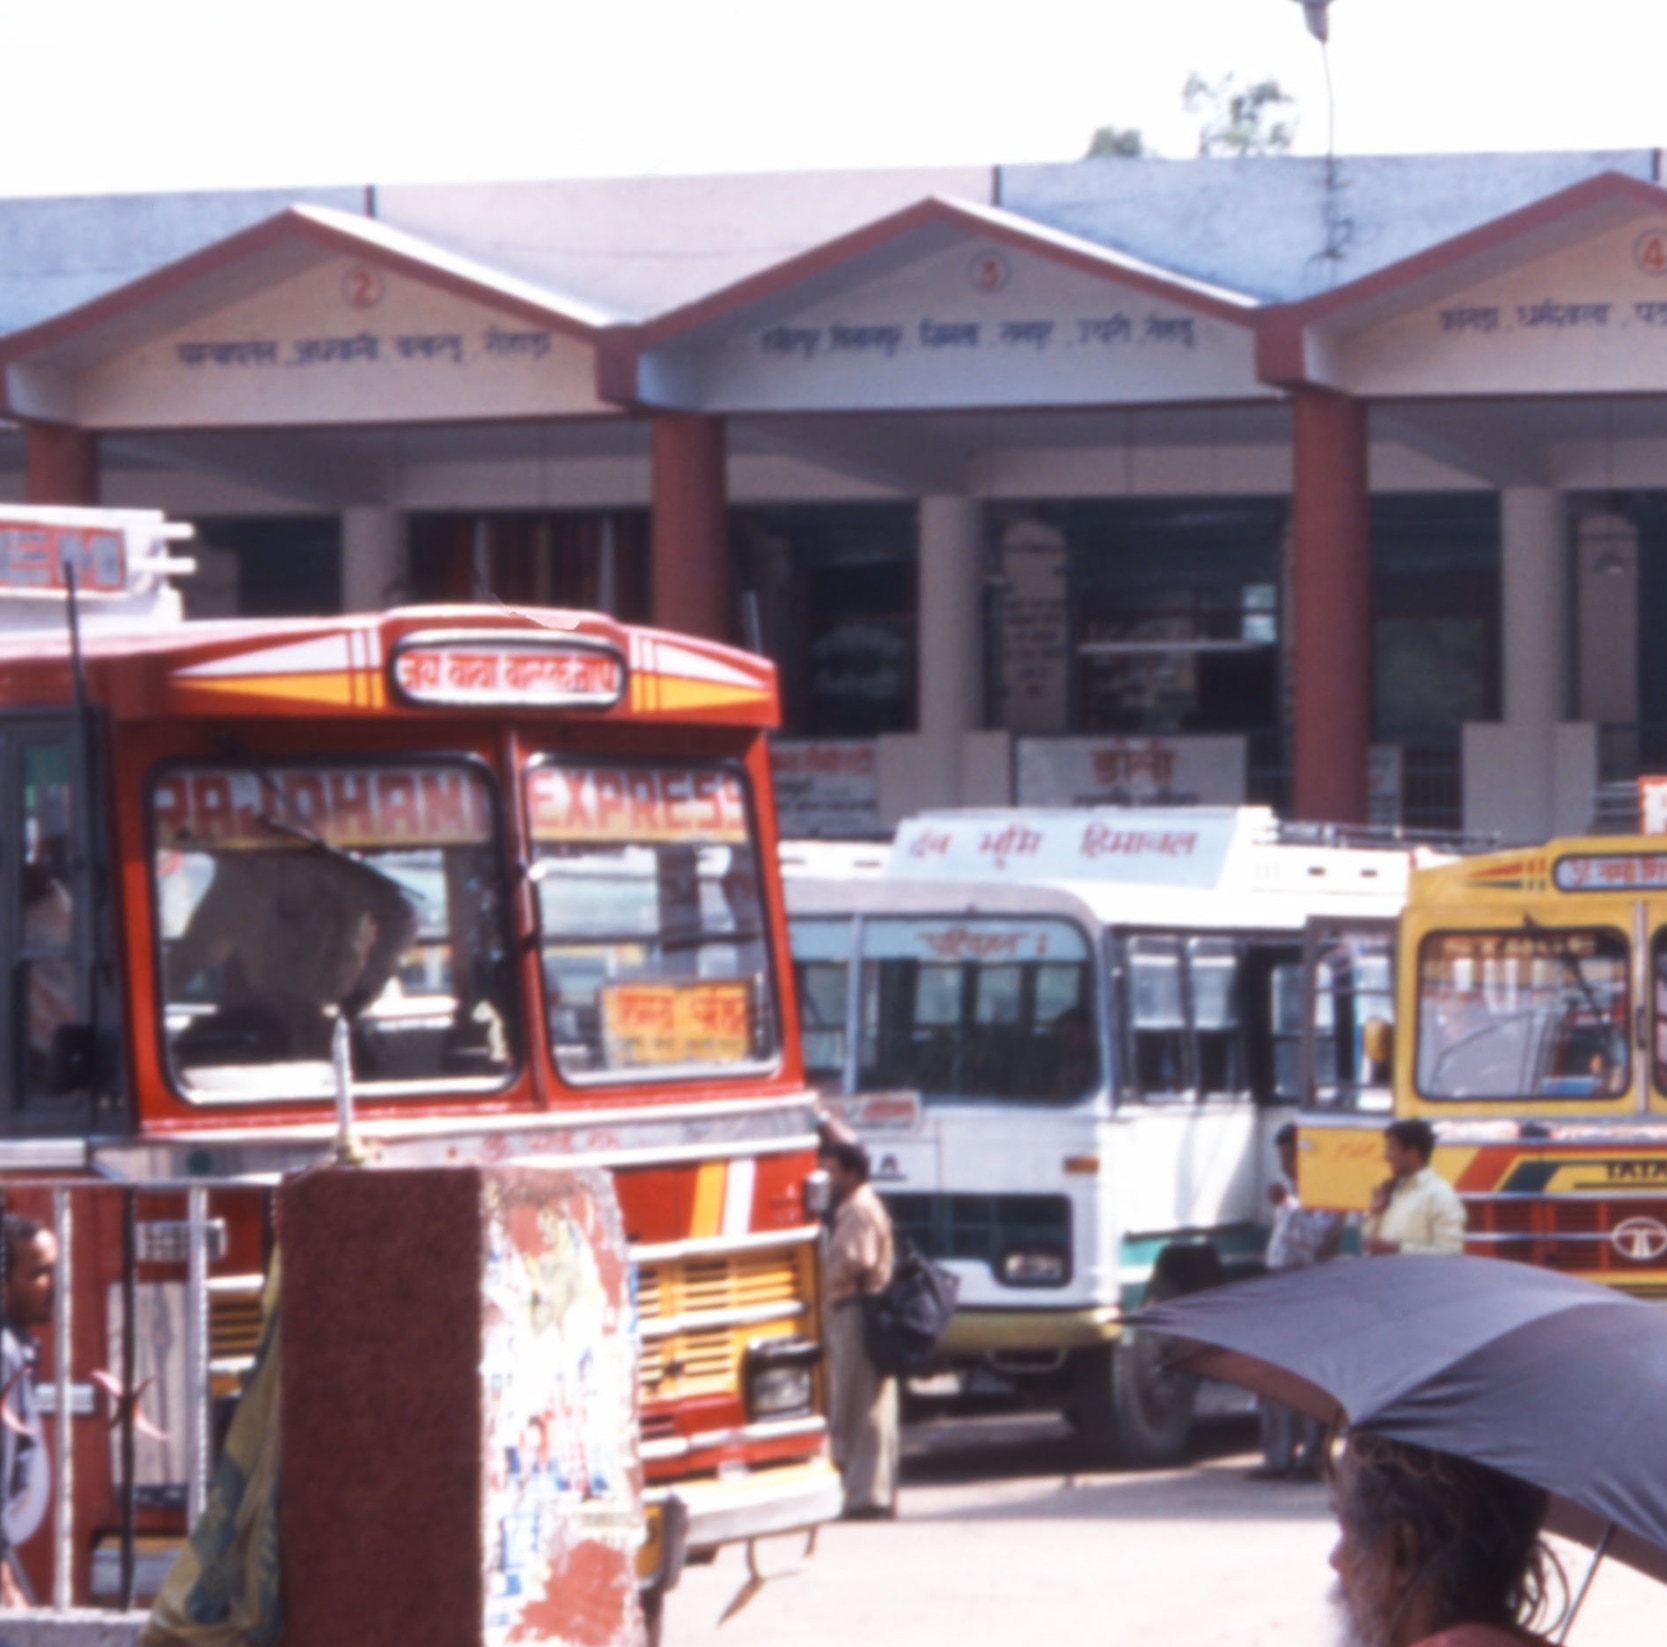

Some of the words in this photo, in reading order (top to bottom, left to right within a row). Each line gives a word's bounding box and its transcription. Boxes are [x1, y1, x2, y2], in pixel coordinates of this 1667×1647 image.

[349, 271, 376, 304] 2
[527, 768, 745, 832] EXPRESS
[1078, 822, 1199, 860] हिमाचल
